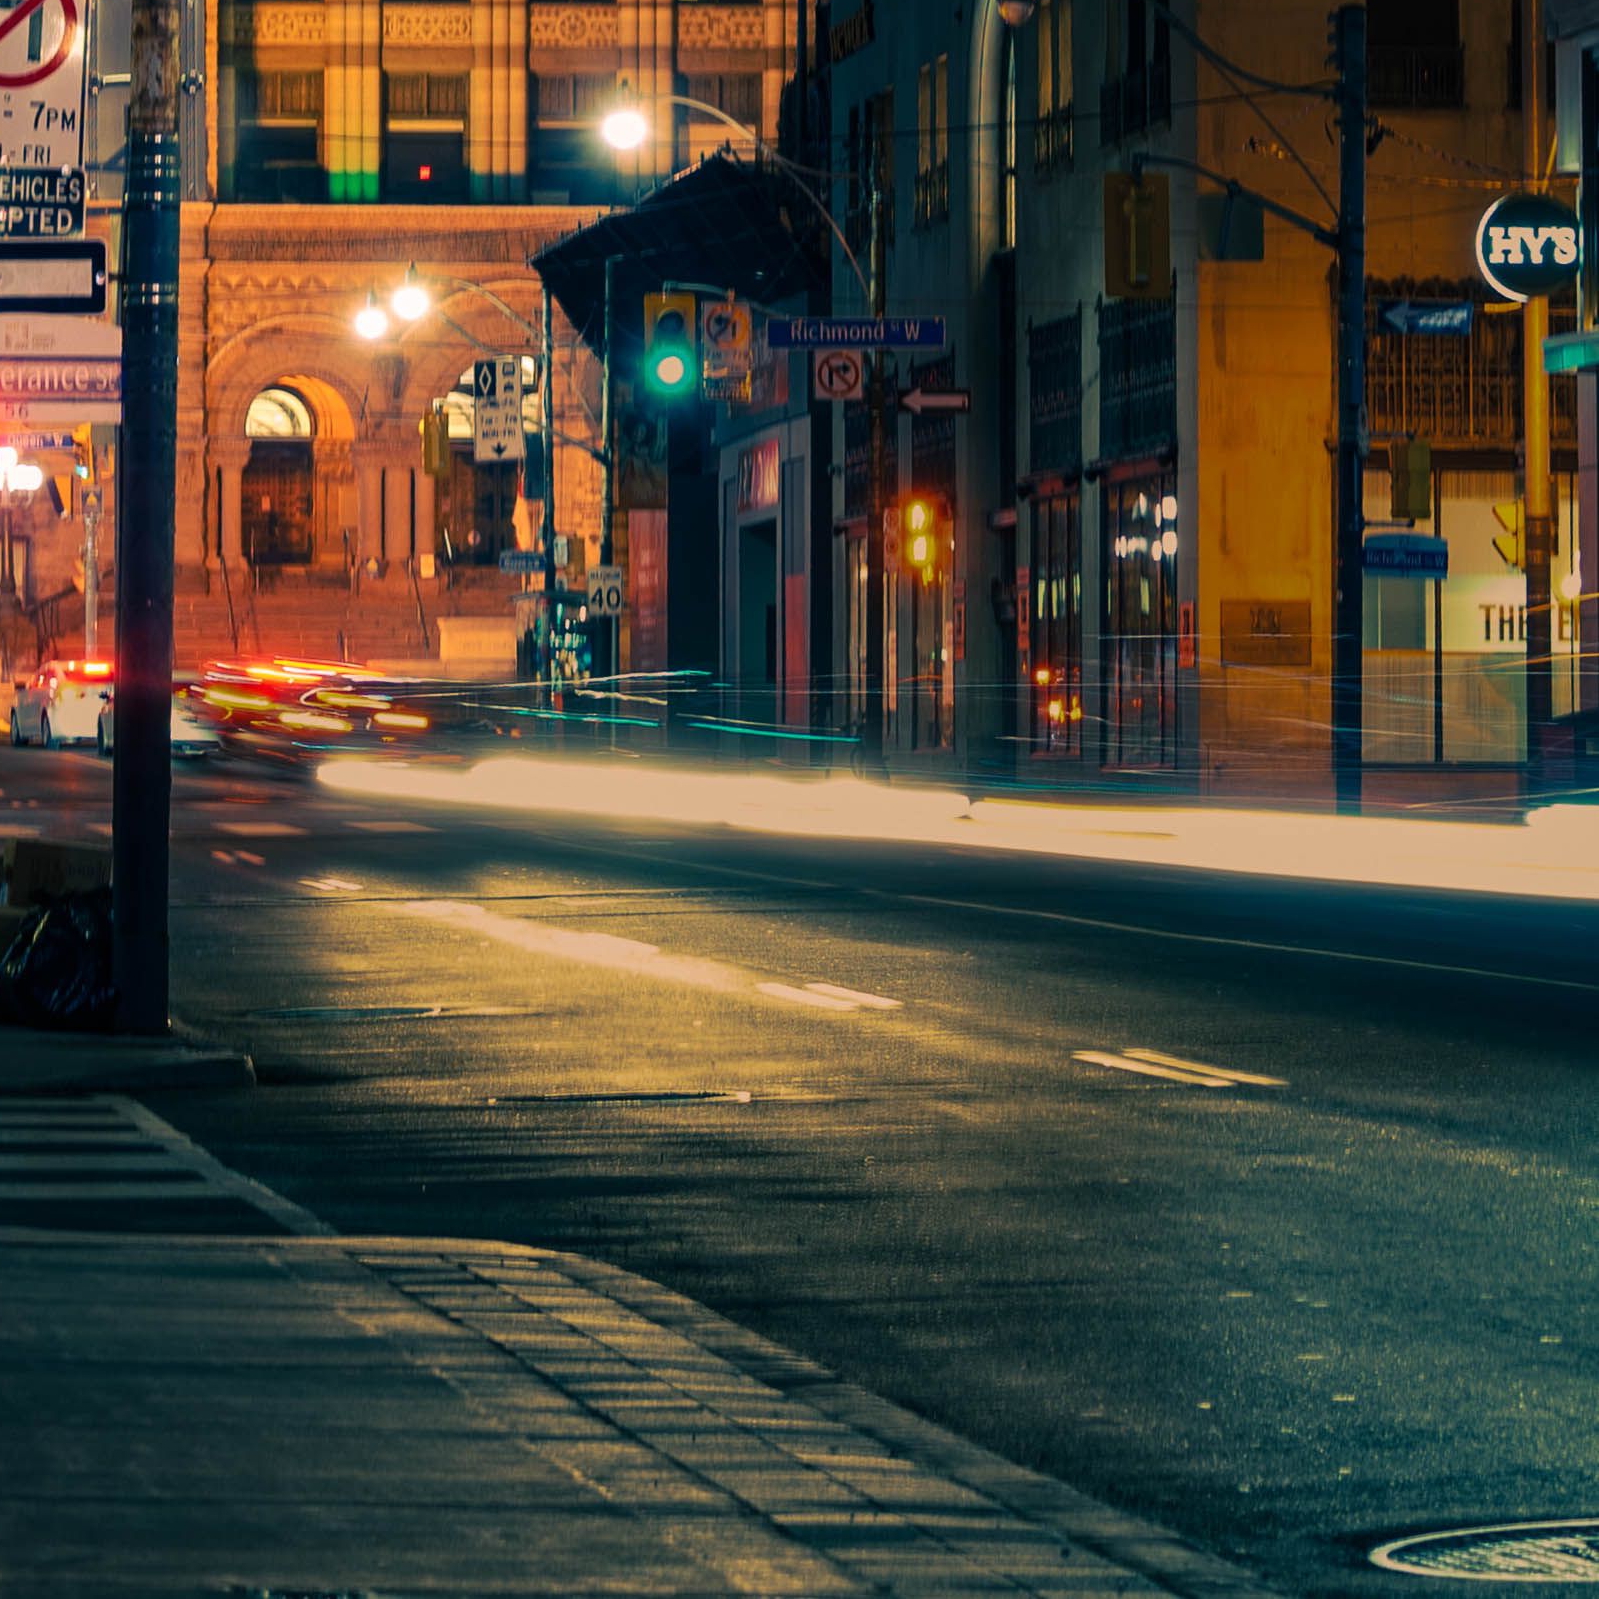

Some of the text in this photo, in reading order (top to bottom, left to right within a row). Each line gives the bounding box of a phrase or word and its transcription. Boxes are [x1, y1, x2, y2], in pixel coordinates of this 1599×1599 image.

[23, 144, 51, 165] FRI
[790, 321, 885, 341] Richmond
[904, 322, 920, 340] W
[591, 586, 620, 611] 40
